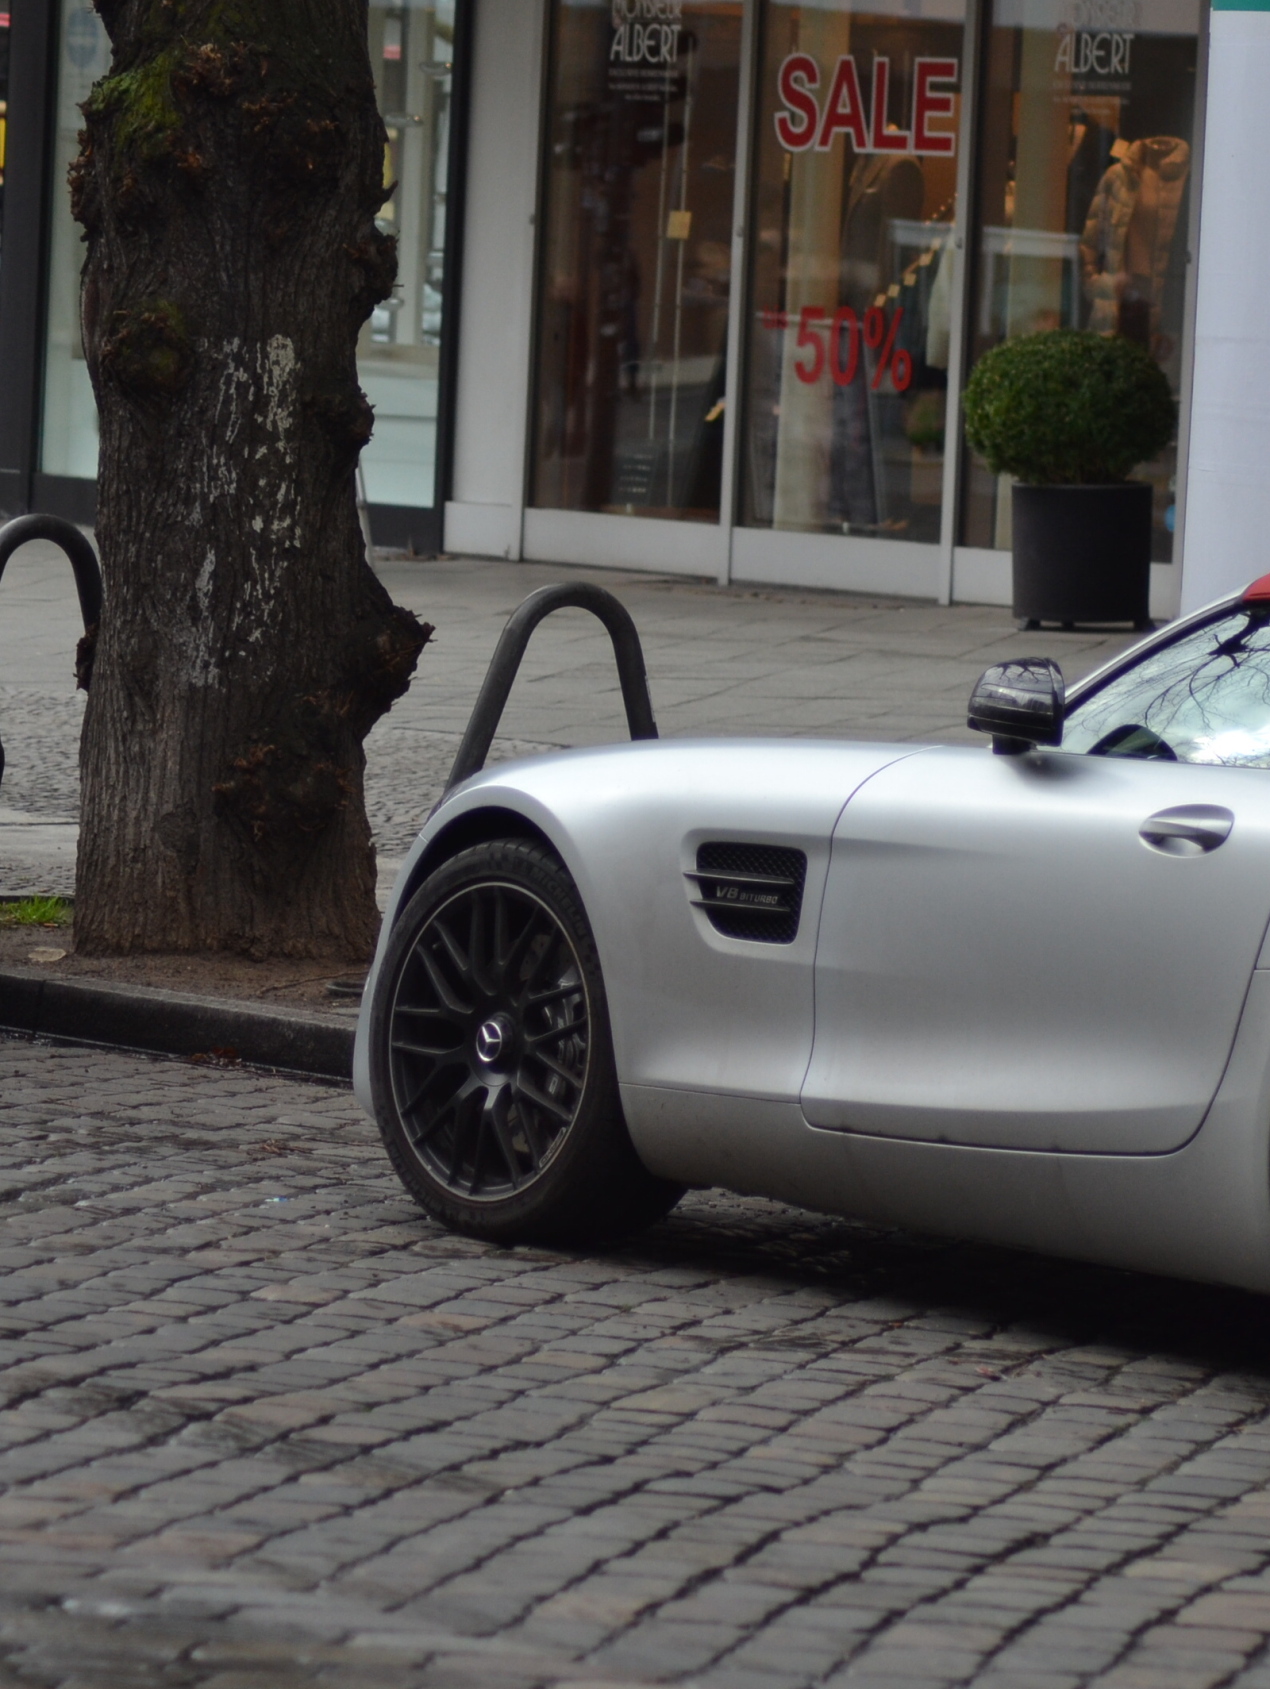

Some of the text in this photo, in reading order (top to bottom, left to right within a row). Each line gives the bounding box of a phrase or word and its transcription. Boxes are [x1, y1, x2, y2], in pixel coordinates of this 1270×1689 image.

[609, 23, 682, 64] ALBERT
[1054, 32, 1135, 74] ALBERT
[774, 54, 959, 157] SALE
[795, 306, 913, 391] 50%
[716, 885, 778, 904] V8 BITURBO
